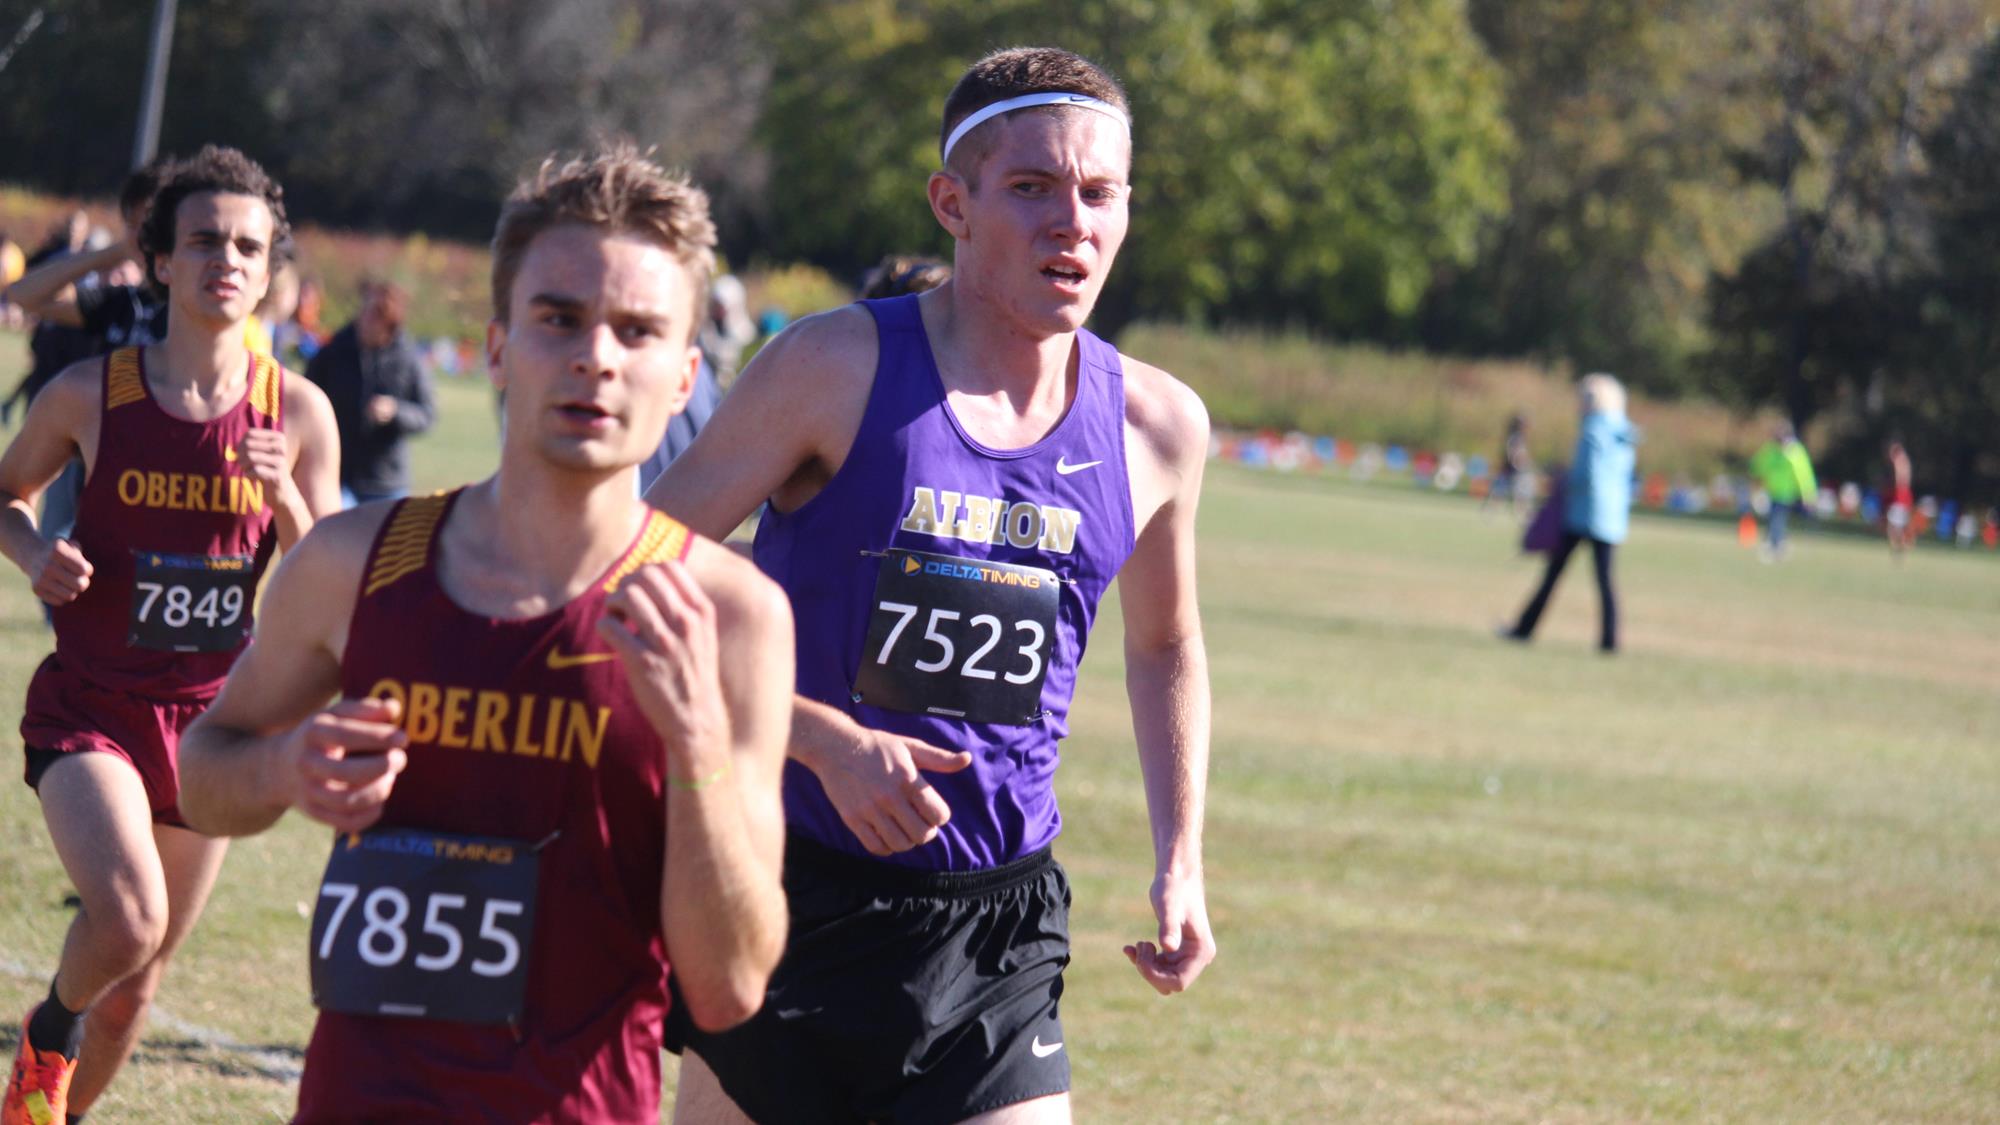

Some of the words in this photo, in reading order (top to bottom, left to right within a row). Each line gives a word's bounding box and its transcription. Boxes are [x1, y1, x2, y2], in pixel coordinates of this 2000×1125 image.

[117, 468, 264, 516] OBERLIN
[900, 486, 1081, 555] ALBION
[924, 560, 1041, 589] DELTATIMING
[136, 581, 244, 628] 7849
[875, 600, 1046, 685] 7523
[318, 882, 524, 978] 7855
